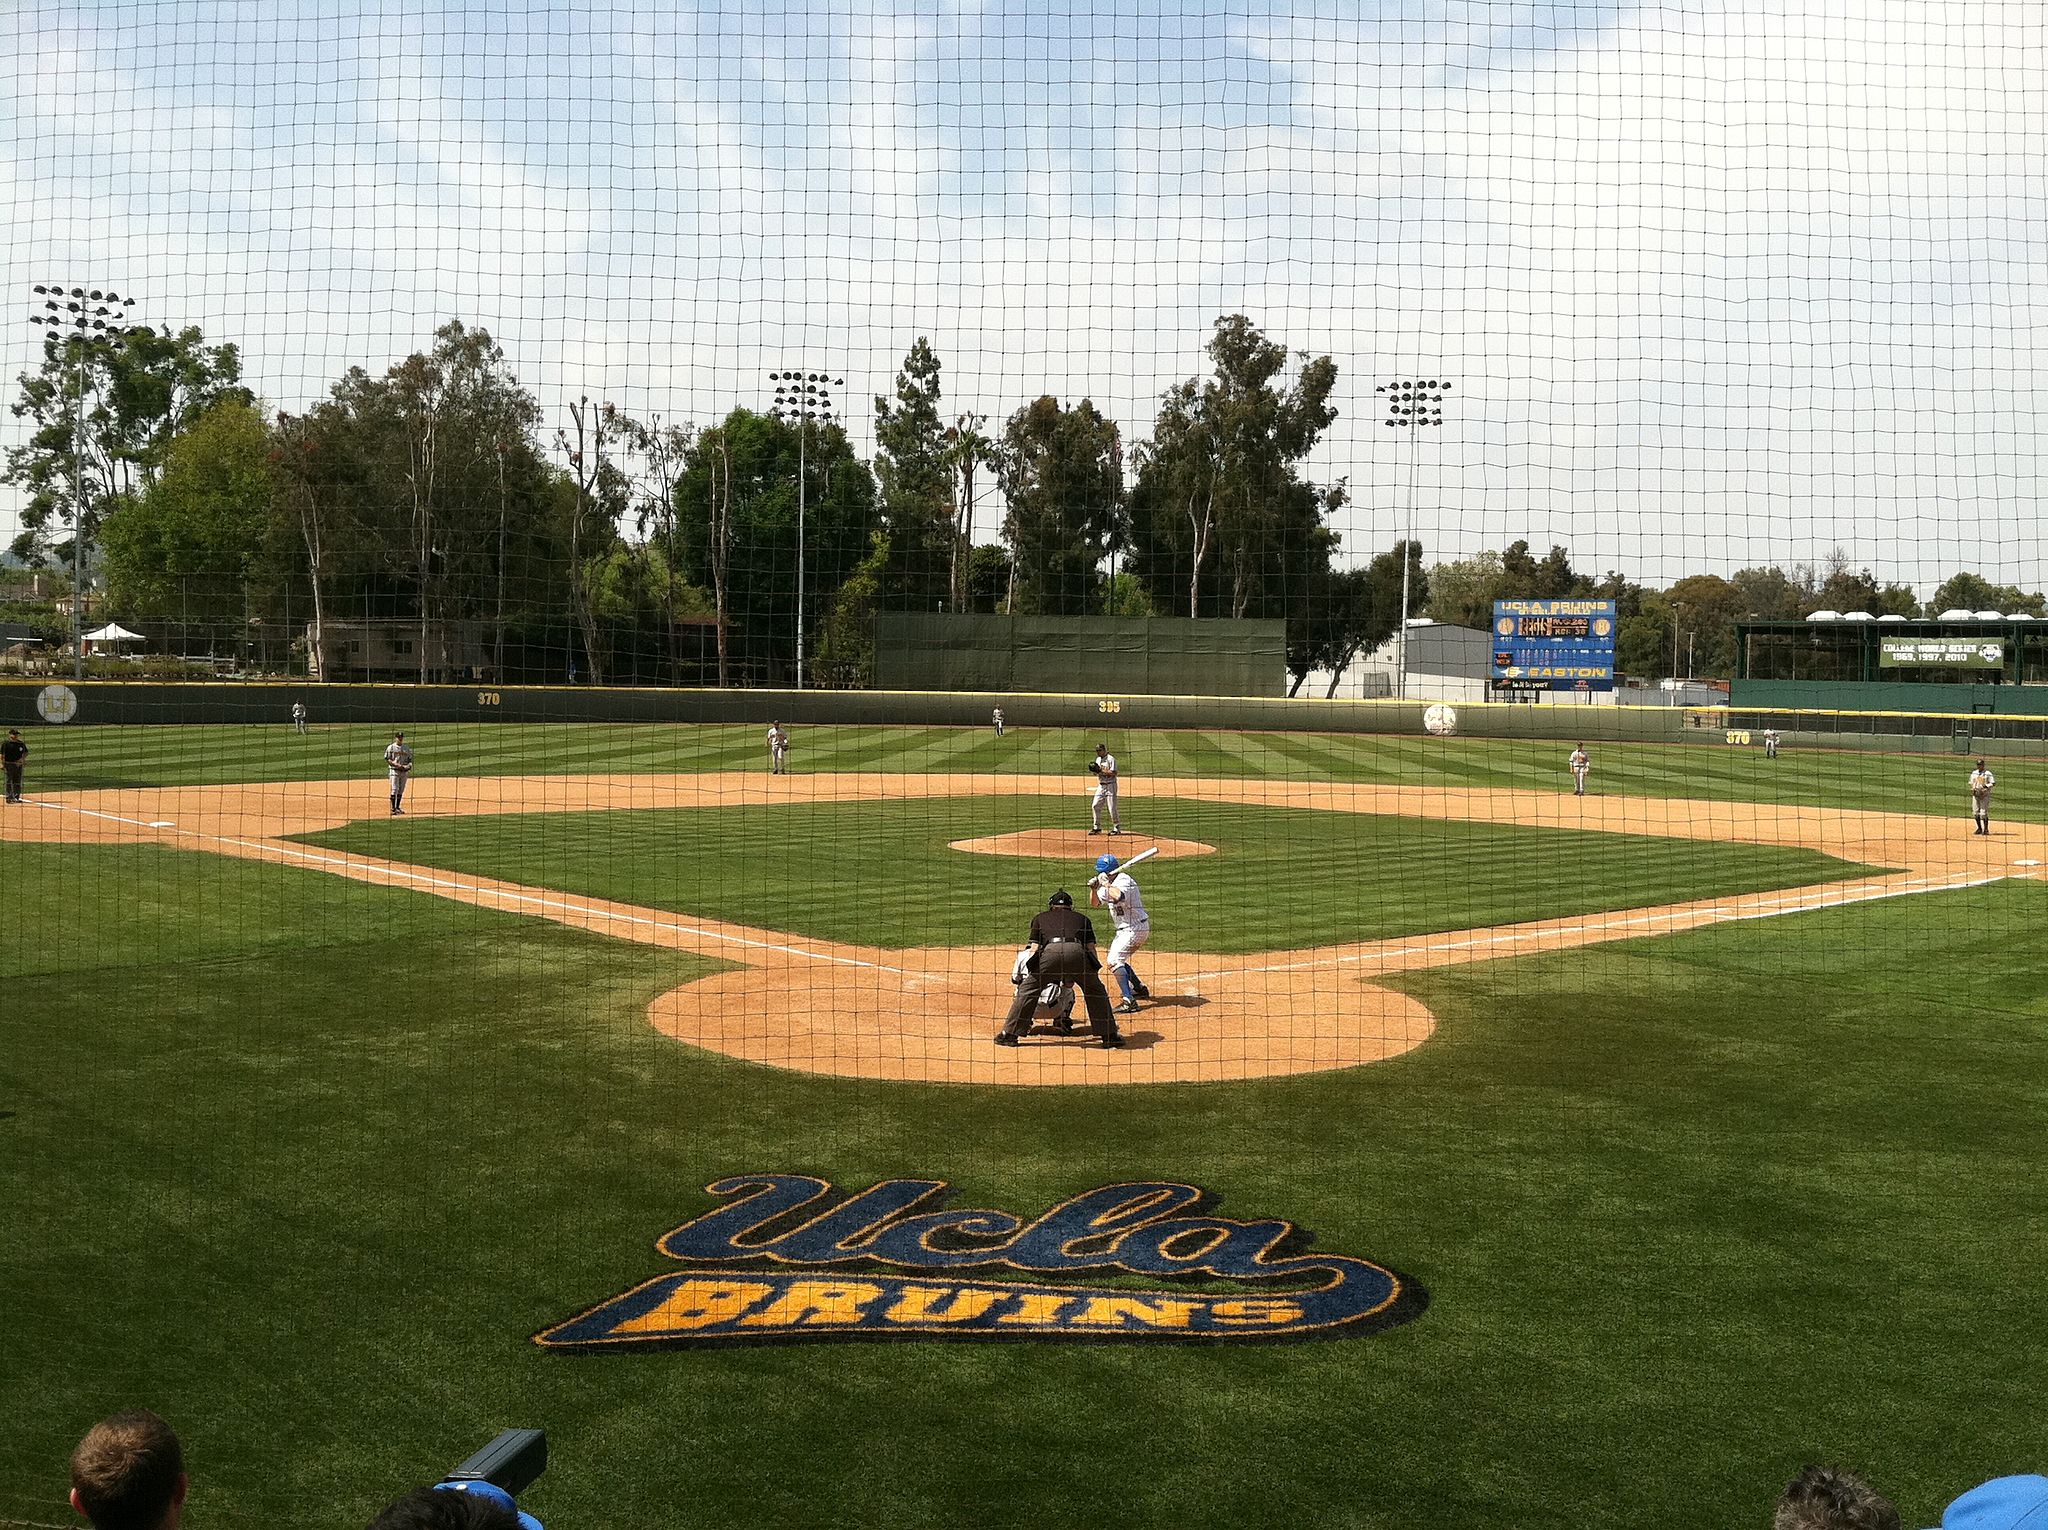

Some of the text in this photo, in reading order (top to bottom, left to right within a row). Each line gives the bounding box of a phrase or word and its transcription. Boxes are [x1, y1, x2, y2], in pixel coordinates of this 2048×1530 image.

[1502, 601, 1608, 610] UCLA BRUINS
[1883, 644, 1977, 653] COLLEGE WORLD SERIES
[1945, 653, 1968, 662] 2010
[1528, 667, 1607, 678] EASTON
[477, 692, 500, 705] 370
[1726, 730, 1750, 745] 370
[609, 1279, 1304, 1333] BRUINS
